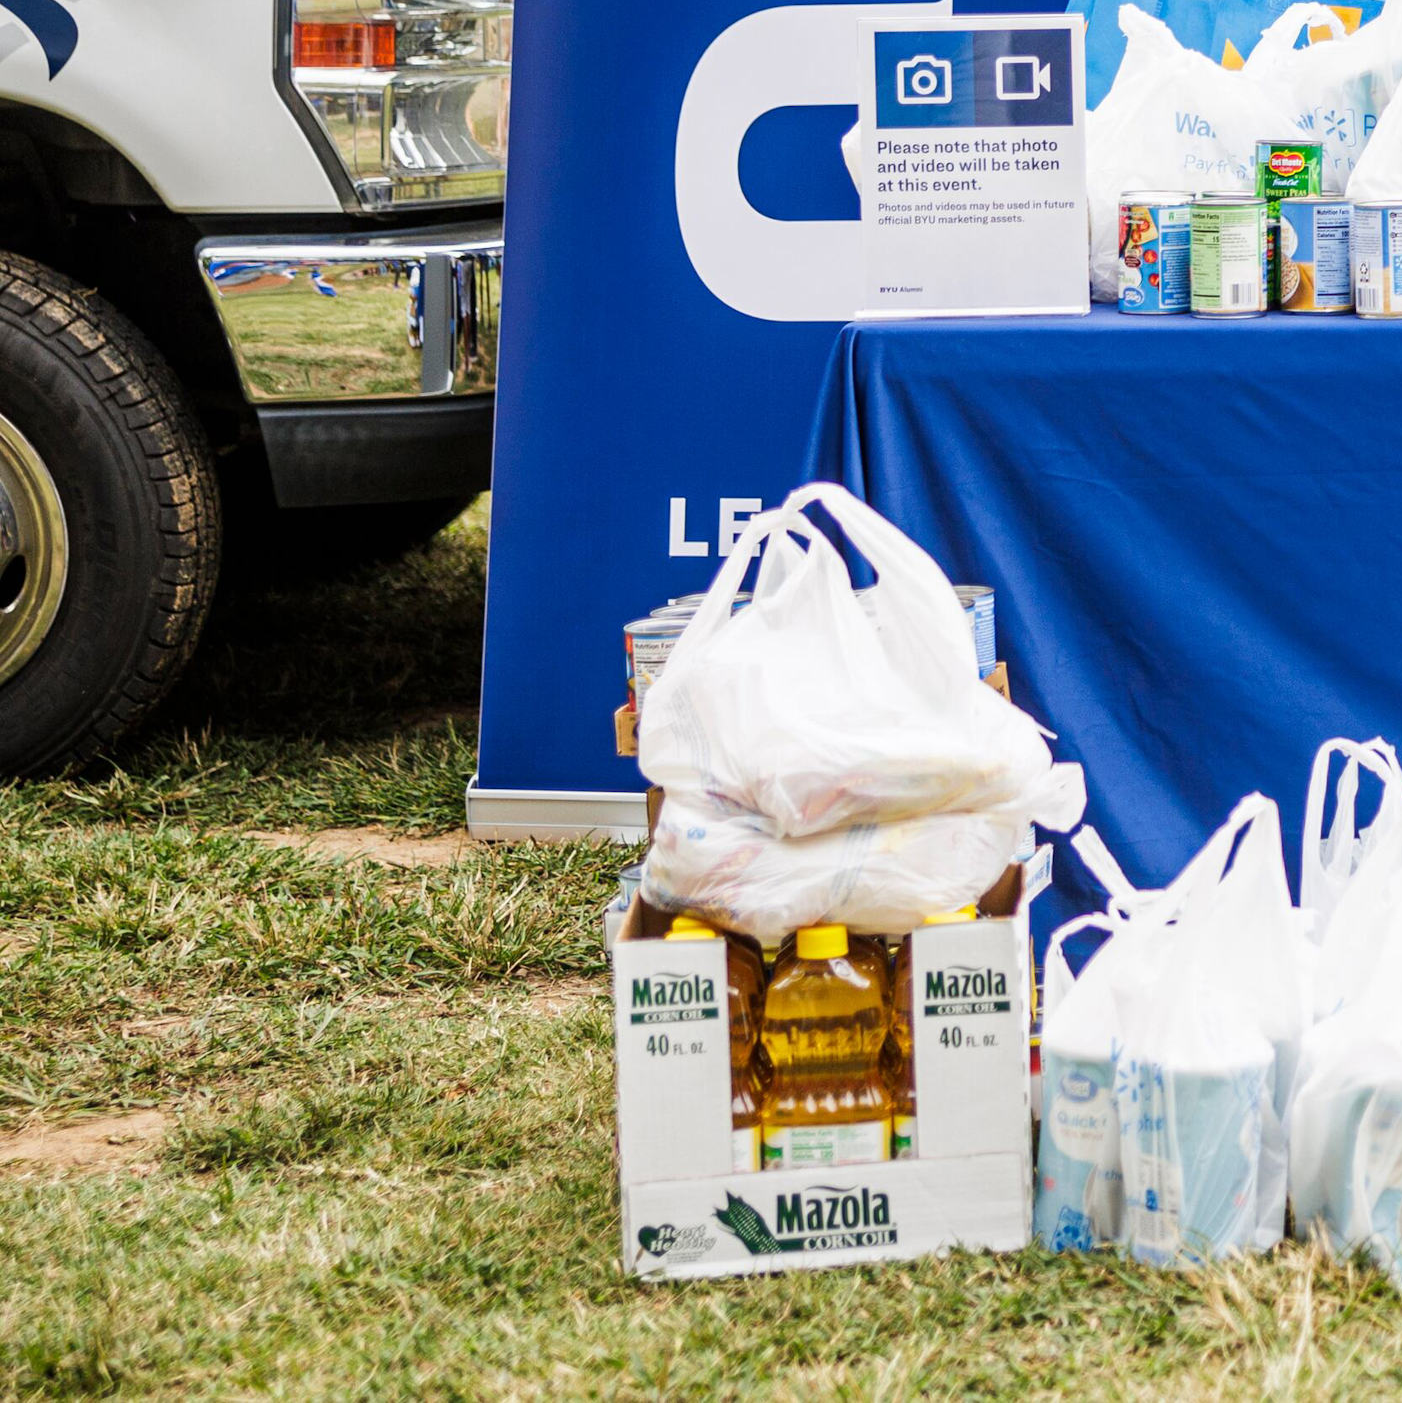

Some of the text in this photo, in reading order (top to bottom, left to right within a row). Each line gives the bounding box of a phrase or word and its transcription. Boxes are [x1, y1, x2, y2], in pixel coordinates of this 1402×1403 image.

[877, 139, 1058, 155] Please note that photo
[878, 157, 1060, 173] and video will be taken
[878, 179, 982, 192] at this event.
[1266, 189, 1307, 197] SWEET PEAS
[878, 200, 1074, 213] Photos and videos may be used in future
[878, 215, 1024, 225] official BYU marketing assets.
[632, 977, 715, 1007] Mazola
[926, 969, 1008, 999] Mazola
[644, 1010, 705, 1023] CORN OIL
[938, 1003, 997, 1016] CORN OIL
[646, 1034, 669, 1056] 40
[673, 1043, 688, 1055] FL.
[940, 1027, 962, 1048] 40
[966, 1037, 979, 1047] FL.
[776, 1187, 893, 1234] Mazola
[803, 1230, 896, 1251] CORN OIL
